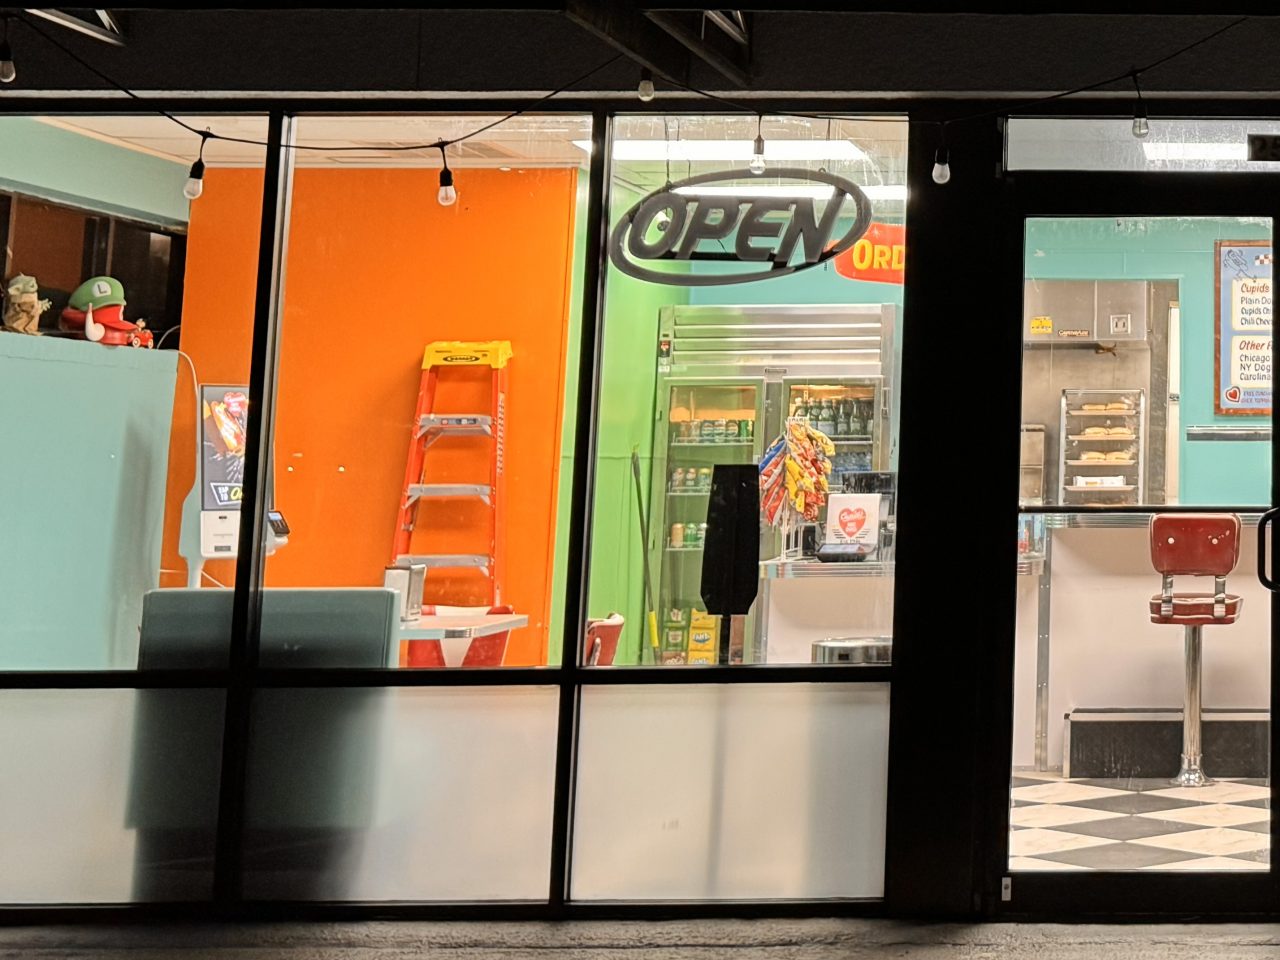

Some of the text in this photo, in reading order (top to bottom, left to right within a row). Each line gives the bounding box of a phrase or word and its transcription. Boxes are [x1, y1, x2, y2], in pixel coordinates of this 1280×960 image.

[627, 188, 848, 264] OPEN
[97, 284, 107, 294] L
[1240, 296, 1260, 305] Plain
[1239, 340, 1265, 351] Other
[1240, 353, 1271, 363] Chicago
[1240, 363, 1252, 371] NY
[1240, 372, 1272, 381] Carolina
